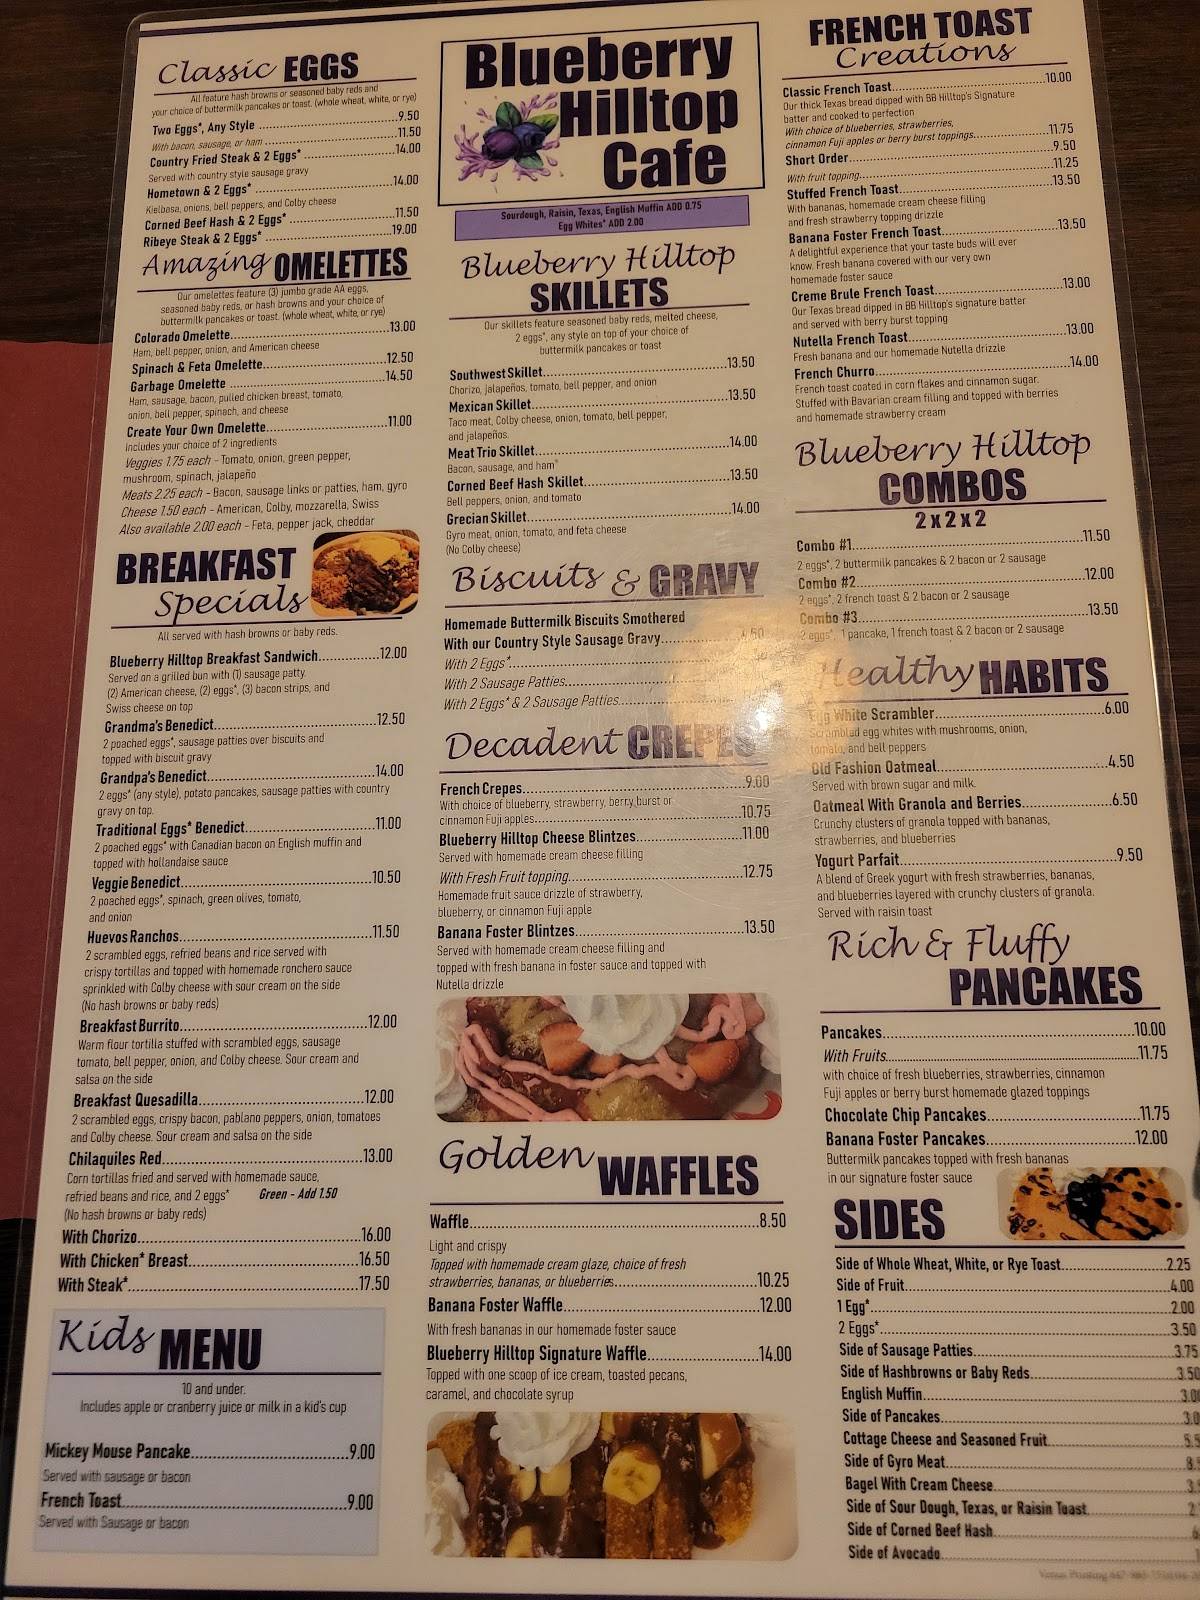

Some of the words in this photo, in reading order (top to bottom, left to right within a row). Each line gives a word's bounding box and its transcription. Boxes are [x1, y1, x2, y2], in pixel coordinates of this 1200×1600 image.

[809, 13, 927, 46] FRENCH
[933, 7, 1033, 39] TOAST
[465, 35, 733, 90] Blueberry
[836, 42, 1017, 69] Creations
[157, 57, 278, 85] Classic
[283, 51, 359, 83] EGGS
[782, 84, 822, 98] Classic
[823, 83, 861, 96] French
[863, 81, 892, 94] Toast
[1045, 71, 1072, 84] 10.00
[559, 86, 738, 138] Hilltop
[151, 141, 169, 153] With
[170, 140, 196, 152] bacon,
[197, 138, 233, 150] sausage,
[235, 138, 244, 147] or
[245, 137, 263, 147] ham
[397, 125, 421, 138] 11.50
[603, 138, 727, 191] Cafe
[785, 153, 815, 167] Short
[818, 152, 849, 165] Order
[1053, 139, 1076, 152] 9.50
[500, 208, 547, 221] Sourdough,
[548, 206, 576, 218] Raisin,
[577, 206, 603, 217] Texas,
[604, 203, 636, 216] English
[637, 202, 664, 213] Muffin
[665, 201, 683, 212] ADD
[685, 200, 702, 211] 0.75
[142, 250, 273, 282] Amazing
[274, 247, 408, 282] OMELETTES
[461, 249, 616, 280] Blueberry
[626, 242, 736, 275] Hilltop
[530, 277, 669, 313] SKILLETS
[132, 362, 174, 375] Spinach
[177, 361, 186, 373] &
[188, 361, 212, 372] Feta
[214, 359, 263, 371] Omelette
[386, 351, 414, 364] 12.50
[793, 352, 818, 363] Fresh
[820, 351, 852, 362] banana
[854, 350, 872, 360] and
[874, 348, 889, 359] our
[890, 346, 939, 358] homemade
[941, 345, 973, 356] Nutella
[974, 343, 1006, 354] drizzle
[447, 447, 475, 460] Meat
[476, 446, 497, 459] Trio
[499, 445, 535, 457] Skillet
[729, 435, 758, 448] 14.00
[795, 435, 962, 468] Blueberry
[973, 428, 1092, 464] Hilltop
[123, 472, 174, 485] mushroom,
[175, 471, 214, 483] spinach,
[216, 468, 257, 483] jalapeño
[878, 467, 1027, 506] COMBOS
[446, 543, 460, 556] (No
[461, 542, 486, 555] Colby
[487, 541, 521, 554] cheese)
[796, 540, 836, 553] Combo
[839, 538, 852, 551] #1
[1082, 529, 1110, 542] 11.50
[116, 547, 296, 585] BREAKFAST
[452, 561, 605, 593] Biscuits
[611, 569, 641, 597] &
[649, 561, 760, 598] GRAVY
[154, 584, 309, 626] Specials
[109, 654, 164, 670] Blueberry
[167, 652, 203, 668] Hilltop
[206, 651, 261, 665] Breakfast
[263, 649, 318, 663] Sandwich
[379, 646, 407, 660] 12.00
[443, 677, 468, 691] With
[470, 677, 477, 689] 2
[479, 676, 526, 691] Sausage
[527, 675, 566, 688] Patties
[979, 656, 1109, 695] HABITS
[445, 726, 623, 761] Decadent
[101, 753, 132, 765] topped
[134, 753, 153, 764] with
[155, 752, 185, 763] biscuit
[186, 751, 212, 764] gravy
[813, 798, 865, 813] Oatmeal
[867, 798, 895, 812] With
[898, 796, 947, 811] Granola
[950, 796, 974, 810] and
[976, 795, 1022, 810] Berries
[1111, 792, 1138, 806] 6.50
[439, 871, 463, 885] With
[466, 871, 497, 884] Fresh
[499, 870, 525, 884] Fruit
[527, 870, 569, 885] topping
[742, 864, 774, 879] 12.75
[817, 905, 851, 919] Served
[853, 905, 875, 918] with
[877, 904, 906, 917] raisin
[908, 904, 933, 916] toast
[87, 929, 128, 944] Huevos
[129, 929, 179, 943] Ranchos
[372, 924, 400, 939] 11.50
[828, 925, 920, 962] Rich
[925, 928, 953, 961] &
[966, 922, 1070, 965] Fluffy
[949, 965, 1144, 1006] PANCAKES
[75, 1075, 100, 1085] salsa
[102, 1075, 114, 1085] on
[116, 1073, 132, 1084] the
[134, 1073, 153, 1084] side
[824, 1107, 889, 1123] Chocolate
[892, 1107, 920, 1125] Chip
[924, 1107, 987, 1122] Pancakes
[1139, 1105, 1170, 1121] 11.75
[68, 1151, 136, 1168] Chilaquiles
[139, 1151, 162, 1165] Red
[363, 1148, 393, 1163] 13.00
[439, 1135, 596, 1174] Golden
[597, 1154, 760, 1196] WAFFLES
[827, 1172, 836, 1184] in
[839, 1173, 857, 1184] our
[859, 1171, 907, 1187] signature
[909, 1171, 939, 1184] foster
[942, 1172, 973, 1184] sauce
[430, 1214, 469, 1230] Waffle
[759, 1212, 787, 1228] 8.50
[834, 1198, 945, 1240] SIDES
[429, 1240, 454, 1253] Light
[456, 1240, 475, 1253] and
[477, 1240, 507, 1254] crispy
[836, 1278, 861, 1292] Side
[863, 1278, 875, 1292] of
[878, 1278, 905, 1292] Fruit
[1170, 1279, 1194, 1293] 4.00
[428, 1296, 475, 1313] Banana
[479, 1296, 519, 1313] Foster
[522, 1296, 563, 1313] Waffle
[760, 1297, 792, 1313] 12.00
[58, 1315, 155, 1354] Kids
[158, 1328, 262, 1370] MENU
[182, 1383, 192, 1395] 10
[195, 1383, 214, 1395] and
[216, 1383, 246, 1395] under.
[843, 1431, 887, 1448] Cottage
[890, 1432, 932, 1446] Cheese
[935, 1432, 957, 1446] and
[960, 1433, 1017, 1447] Seasoned
[1020, 1433, 1048, 1447] Fruit
[45, 1443, 89, 1462] Mickey
[92, 1443, 133, 1459] Mouse
[136, 1444, 191, 1459] Pancake
[349, 1444, 375, 1460] 9.00
[848, 1545, 874, 1559] Side
[877, 1546, 889, 1559] of
[892, 1546, 941, 1560] Avocado
